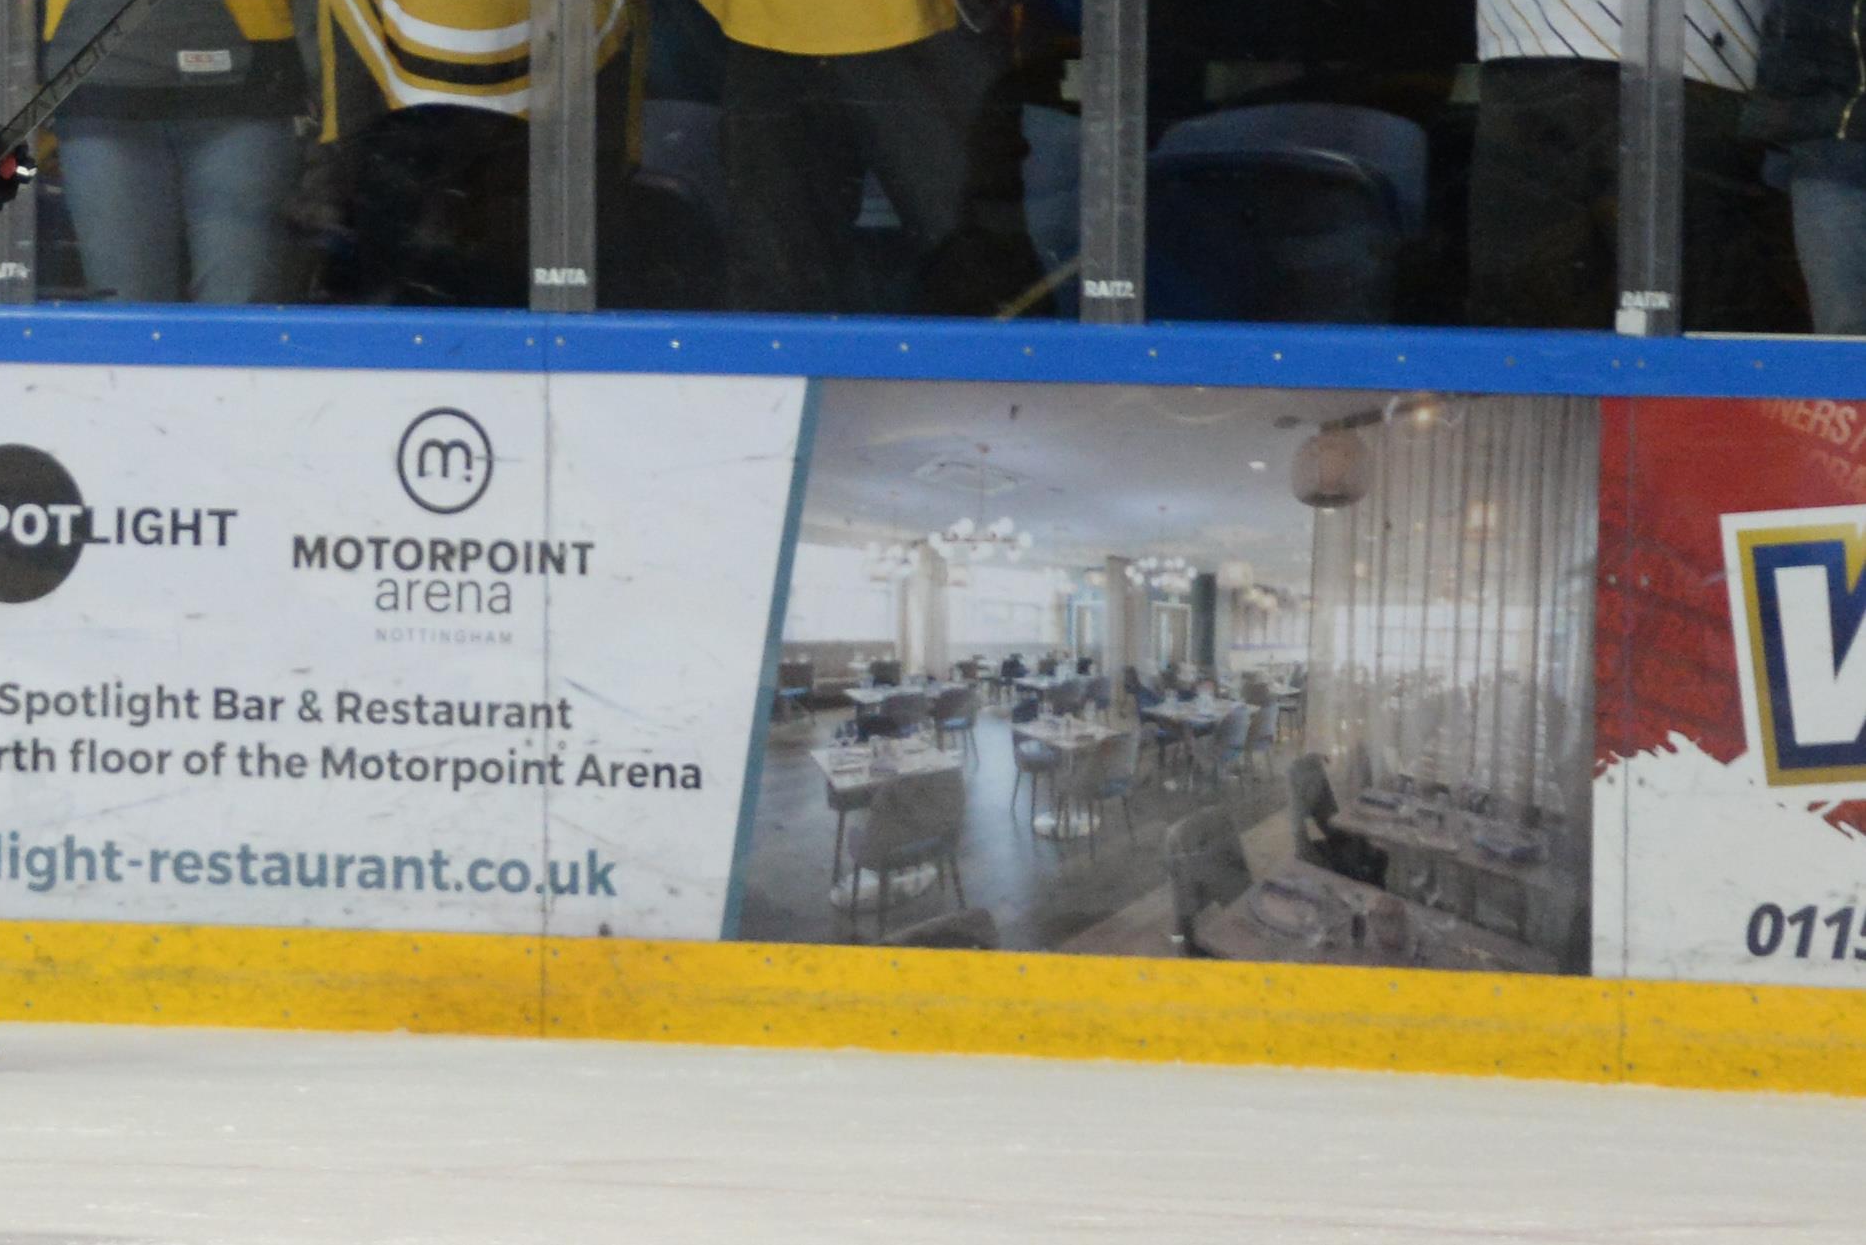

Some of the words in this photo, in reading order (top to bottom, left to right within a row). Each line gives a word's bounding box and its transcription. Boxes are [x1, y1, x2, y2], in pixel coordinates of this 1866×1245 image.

[293, 535, 596, 577] MOTORPOINT
[375, 578, 512, 615] arena
[375, 628, 513, 644] NOTTINGHAM
[213, 687, 285, 722] Bar
[297, 689, 323, 723] &
[336, 690, 572, 730] Restaurant
[69, 738, 172, 775] floor
[183, 741, 226, 776] of
[237, 742, 308, 779] the
[321, 746, 564, 792] Motorpoint
[575, 753, 702, 790] Arena
